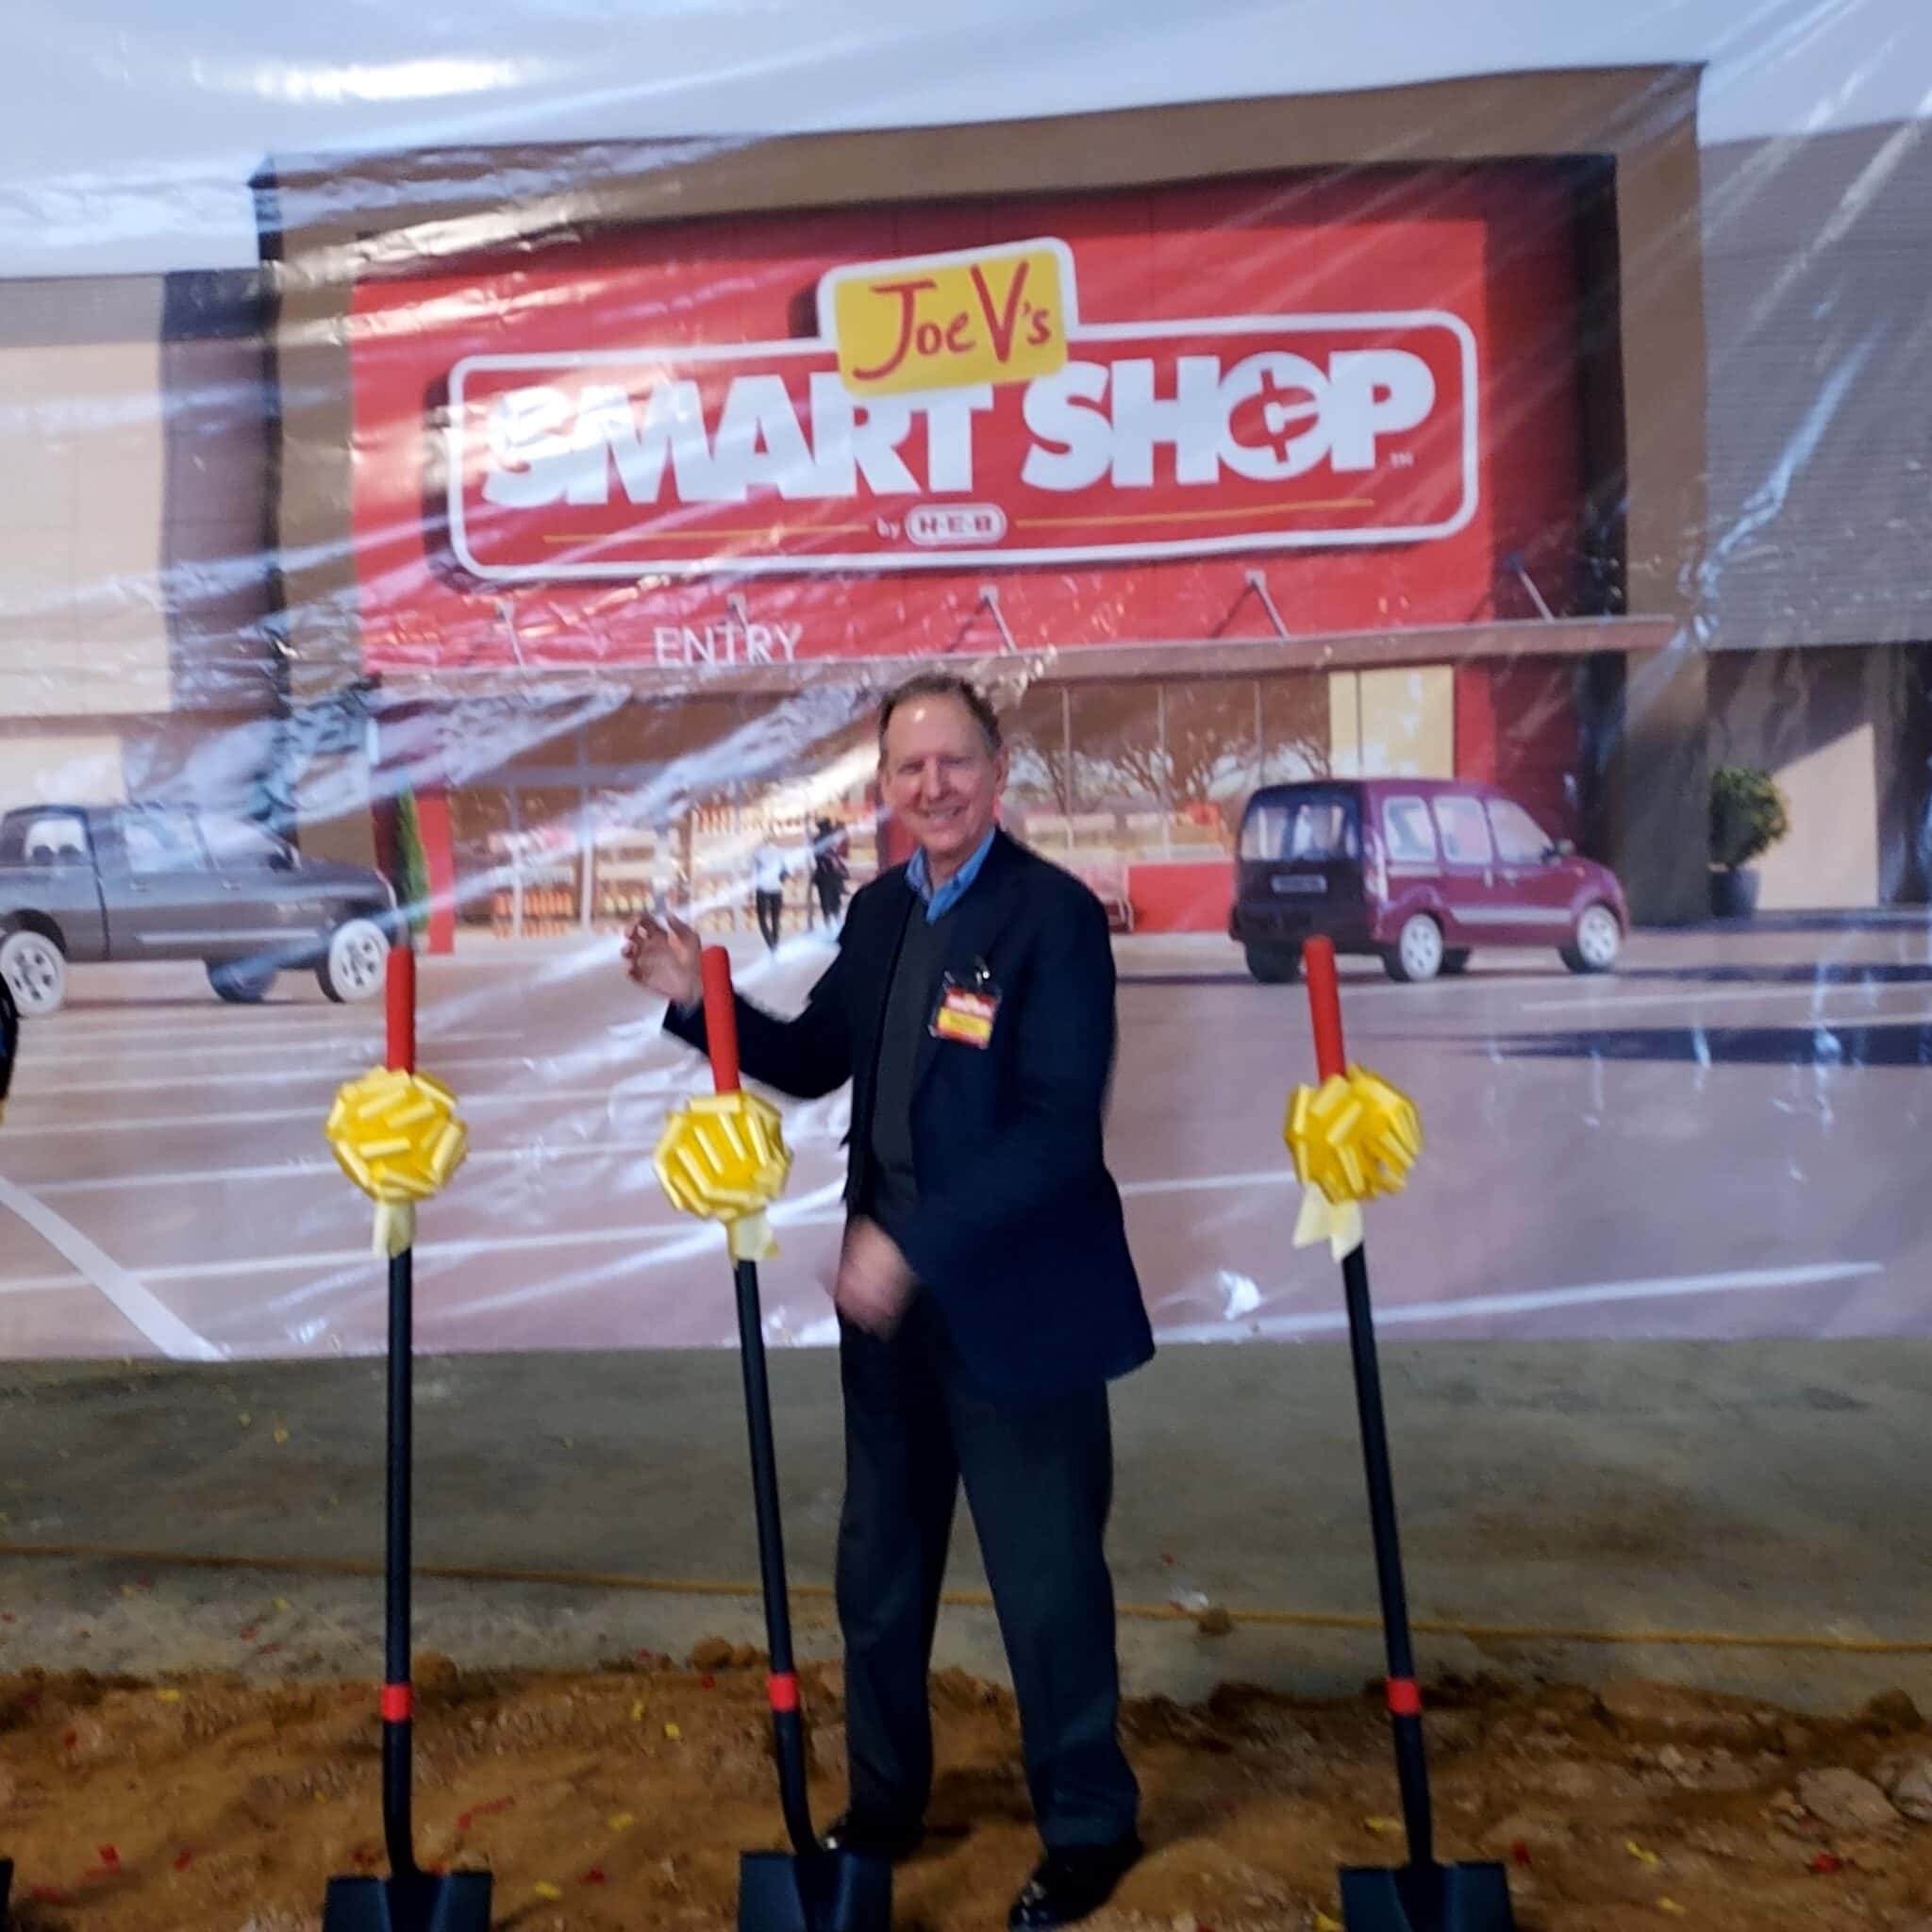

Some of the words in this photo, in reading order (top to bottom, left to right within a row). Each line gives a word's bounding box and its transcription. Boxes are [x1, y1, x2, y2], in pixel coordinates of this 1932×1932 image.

[853, 278, 976, 381] Joe
[481, 373, 994, 508] SMART
[1021, 349, 1436, 491] SHOP
[876, 516, 901, 541] by
[653, 621, 803, 668] ENTRY
